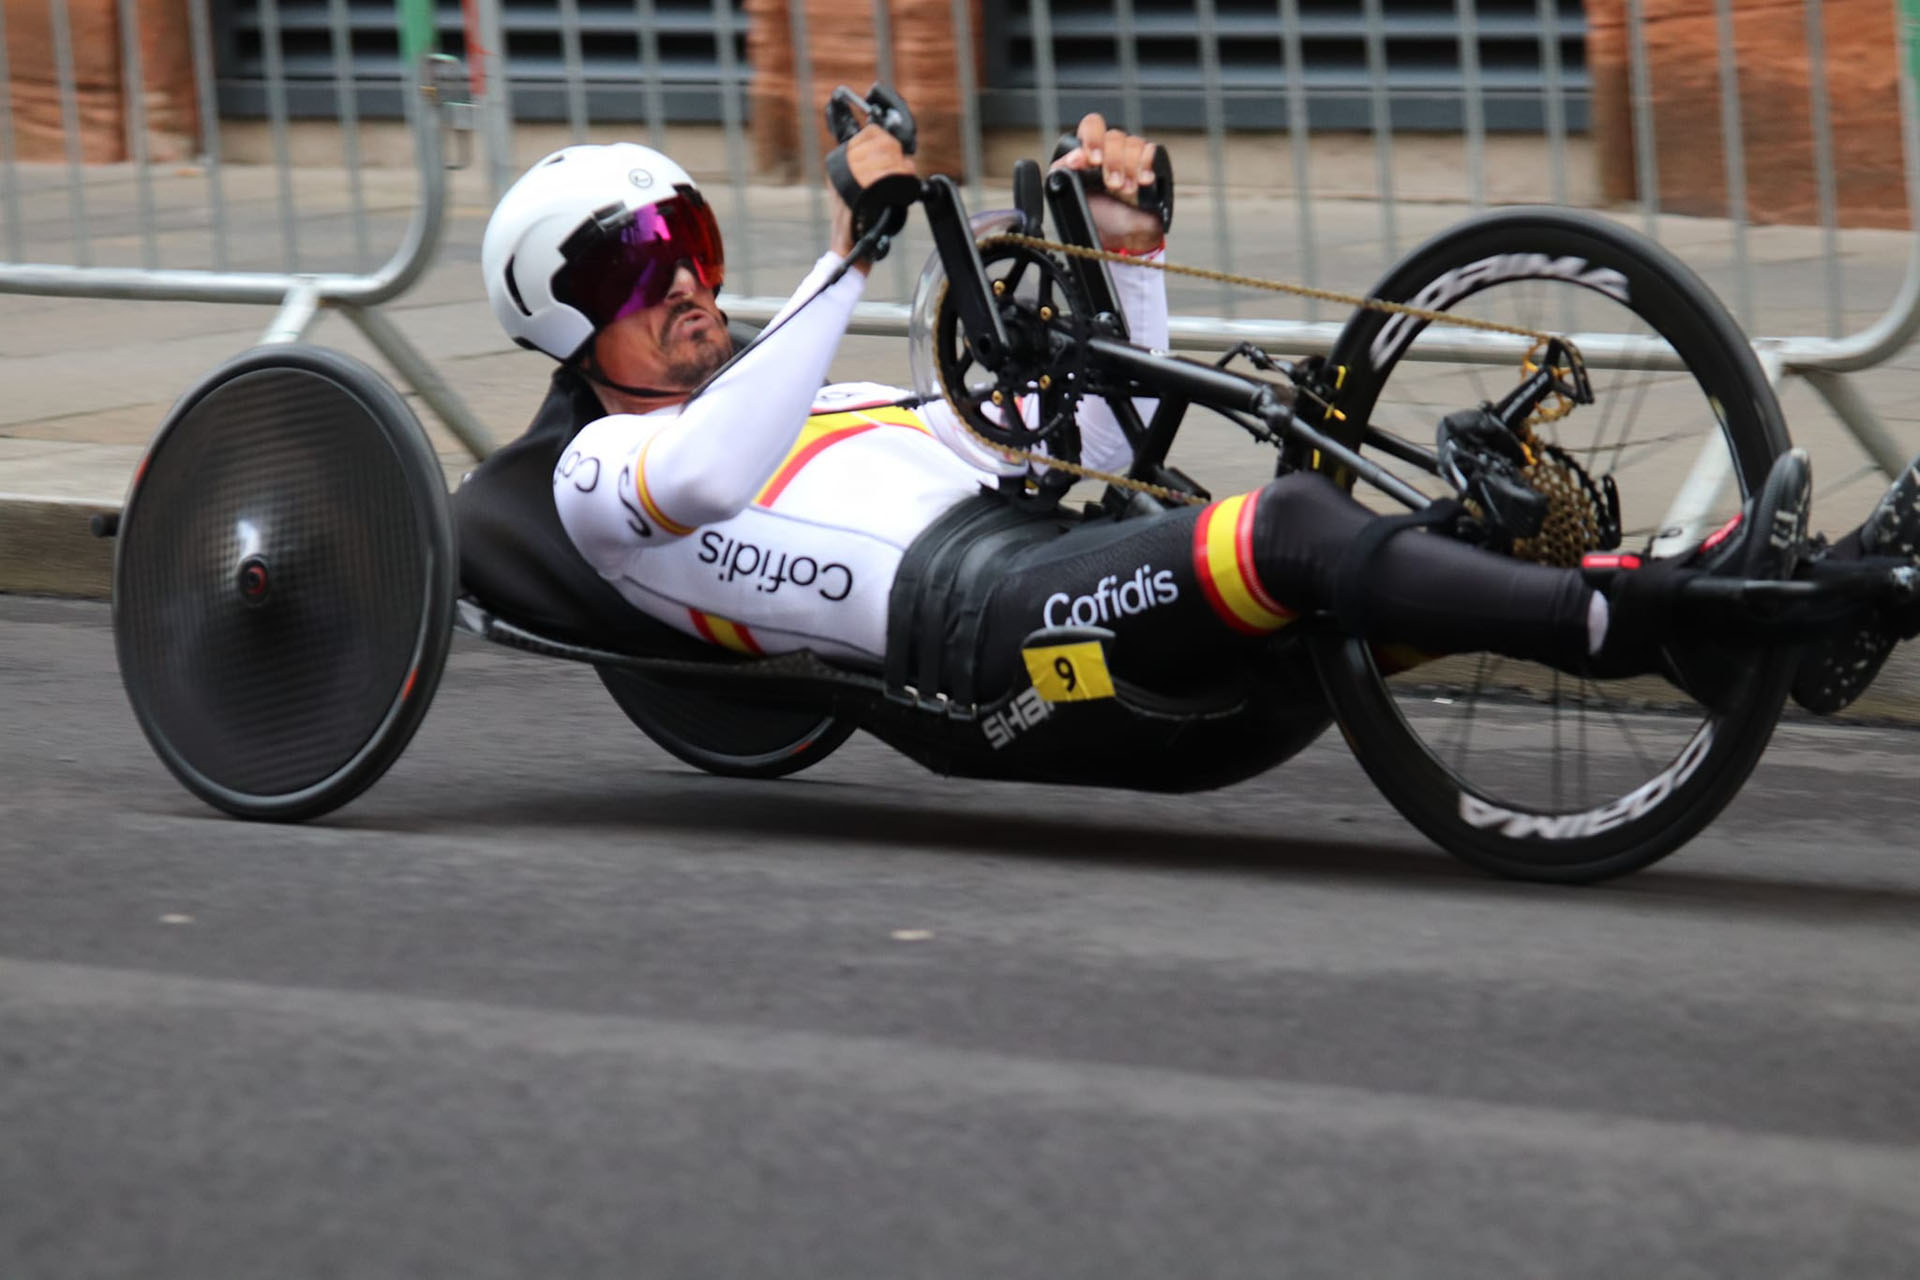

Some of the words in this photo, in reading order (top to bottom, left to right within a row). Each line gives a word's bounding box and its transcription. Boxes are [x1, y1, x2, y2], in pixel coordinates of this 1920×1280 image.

[697, 530, 854, 602] Cofidis
[1043, 563, 1180, 630] Cofidis
[1053, 656, 1077, 693] 9
